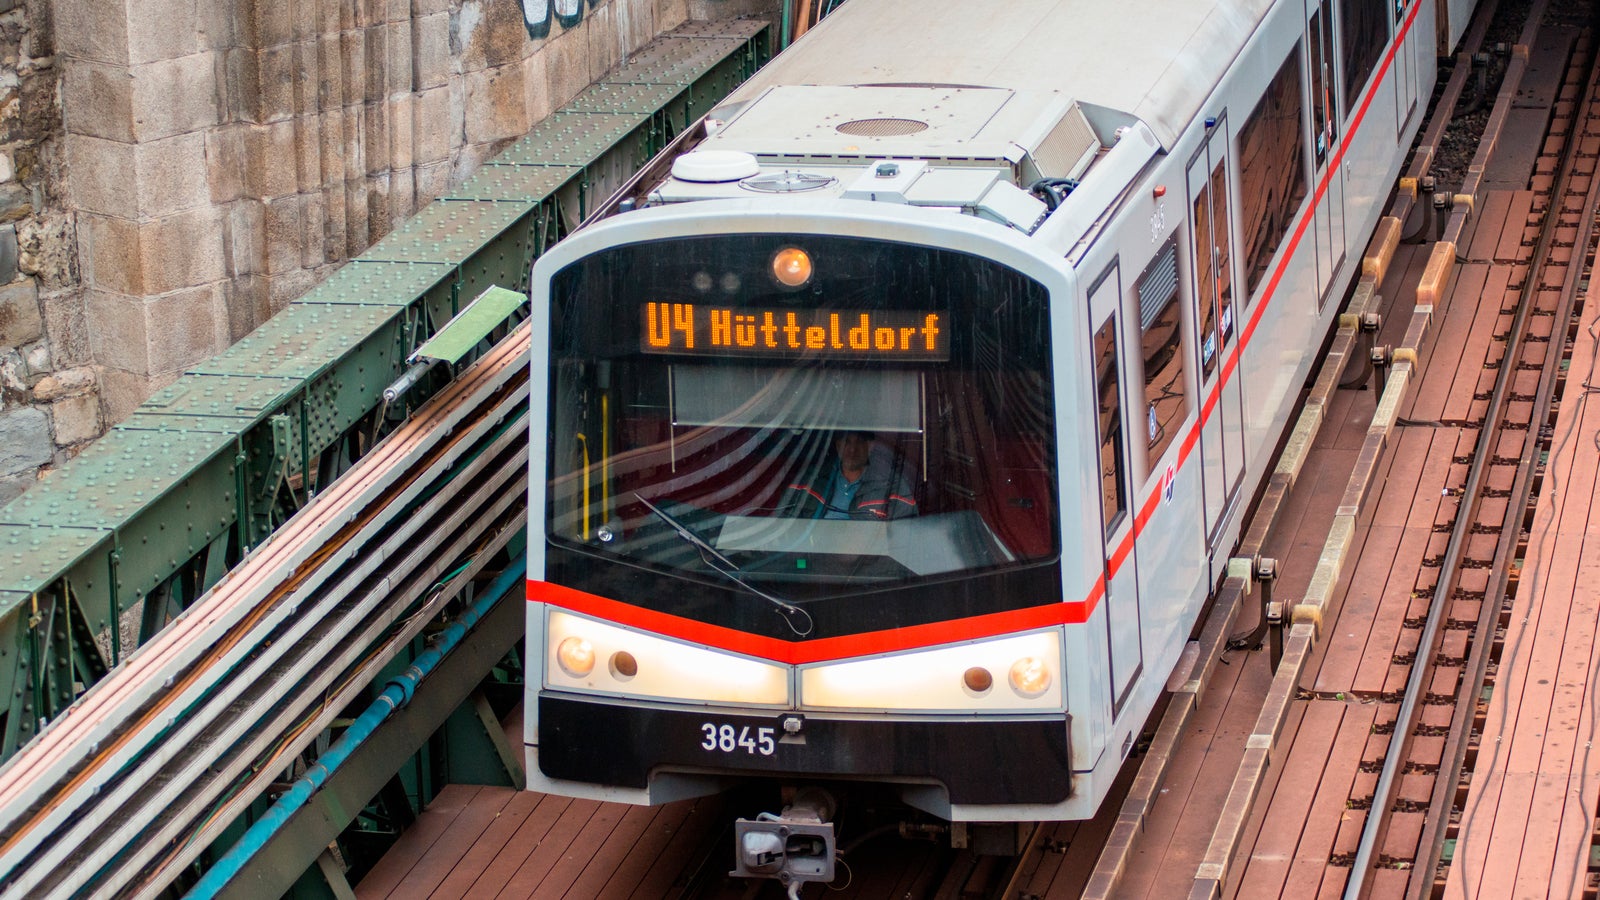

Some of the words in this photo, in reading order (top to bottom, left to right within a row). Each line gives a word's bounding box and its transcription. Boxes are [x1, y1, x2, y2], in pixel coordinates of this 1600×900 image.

[648, 302, 694, 348] U4
[711, 309, 939, 350] Hütteldorf
[701, 722, 775, 756] 3845
